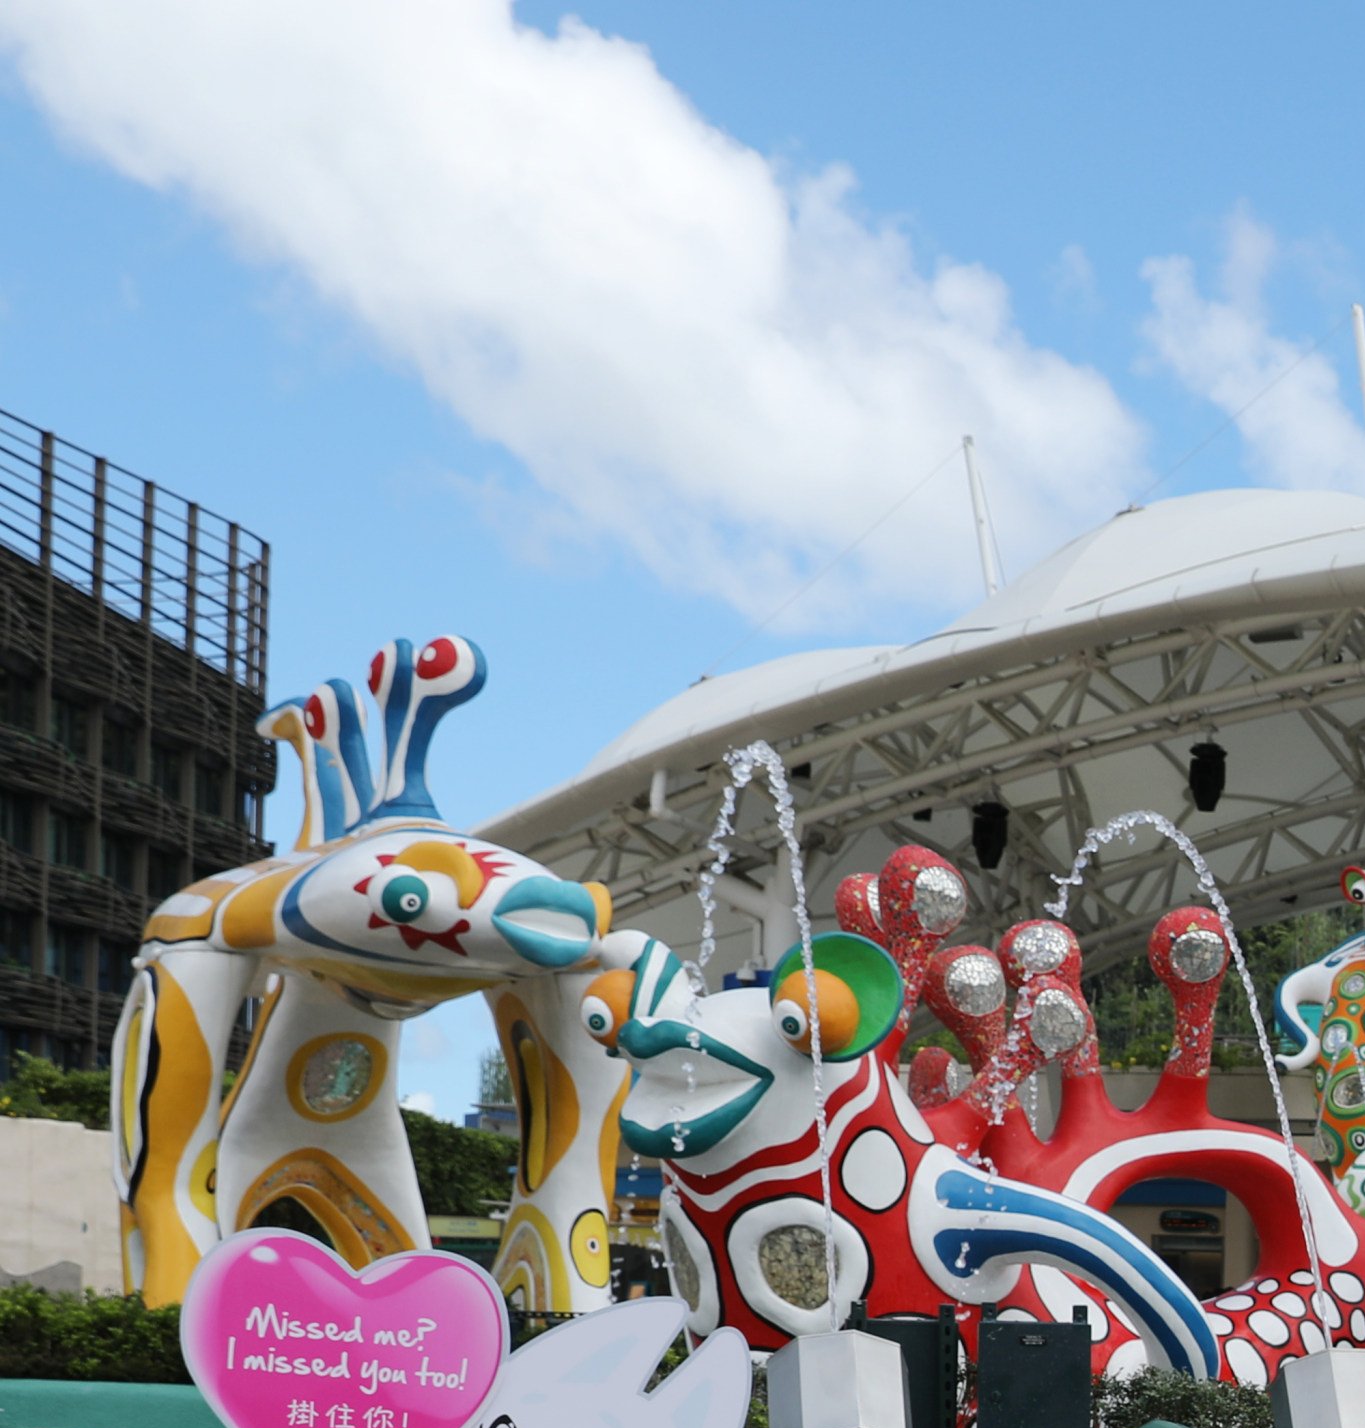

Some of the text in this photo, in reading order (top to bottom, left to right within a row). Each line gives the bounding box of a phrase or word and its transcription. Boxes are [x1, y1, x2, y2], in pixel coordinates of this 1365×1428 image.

[245, 1302, 438, 1351] Missed me?
[226, 1336, 469, 1396] I missed you too!
